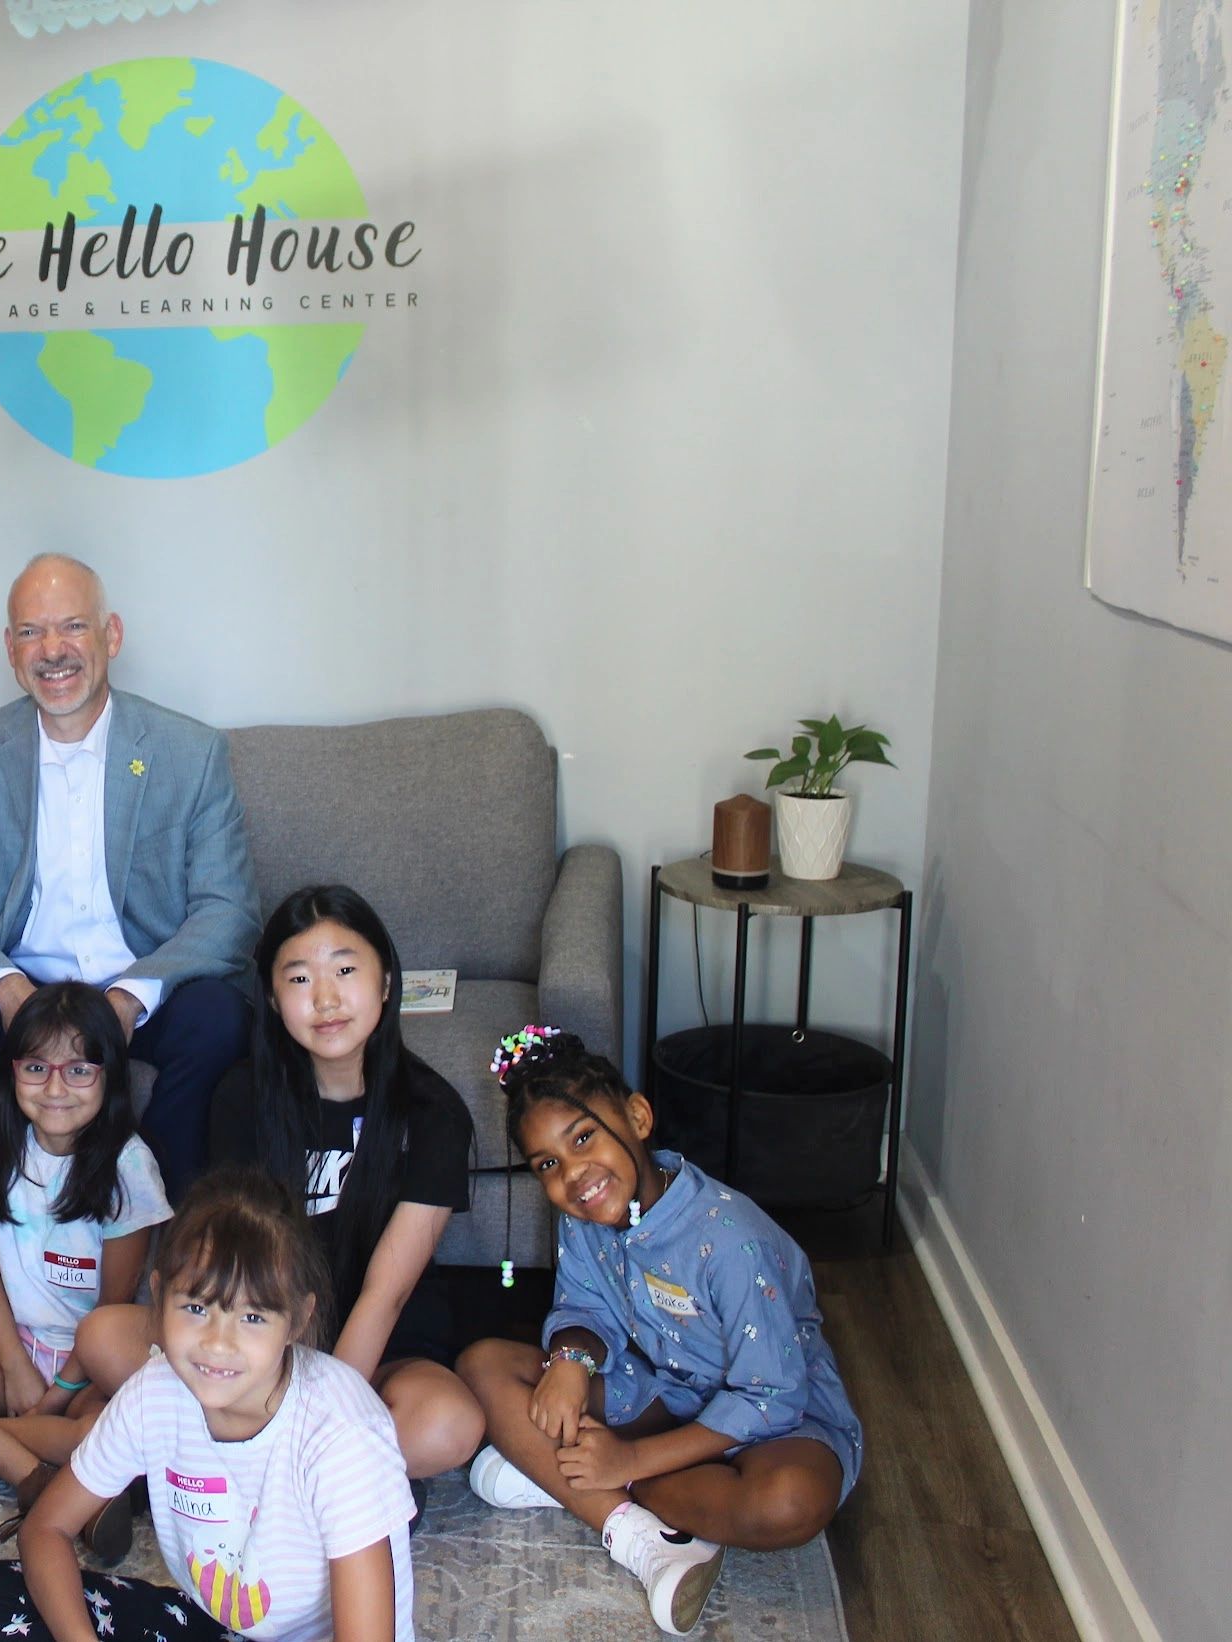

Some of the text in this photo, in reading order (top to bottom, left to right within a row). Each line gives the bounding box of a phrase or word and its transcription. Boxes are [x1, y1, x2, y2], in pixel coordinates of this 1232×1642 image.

[39, 203, 194, 292] Hello
[227, 203, 422, 286] House
[84, 302, 96, 316] &
[120, 296, 275, 315] LEARNING
[299, 292, 419, 309] CENTER
[57, 1255, 80, 1265] HELLO
[50, 1264, 86, 1283] Lydia
[177, 1475, 205, 1488] HELLO
[173, 1490, 216, 1516] Alina
